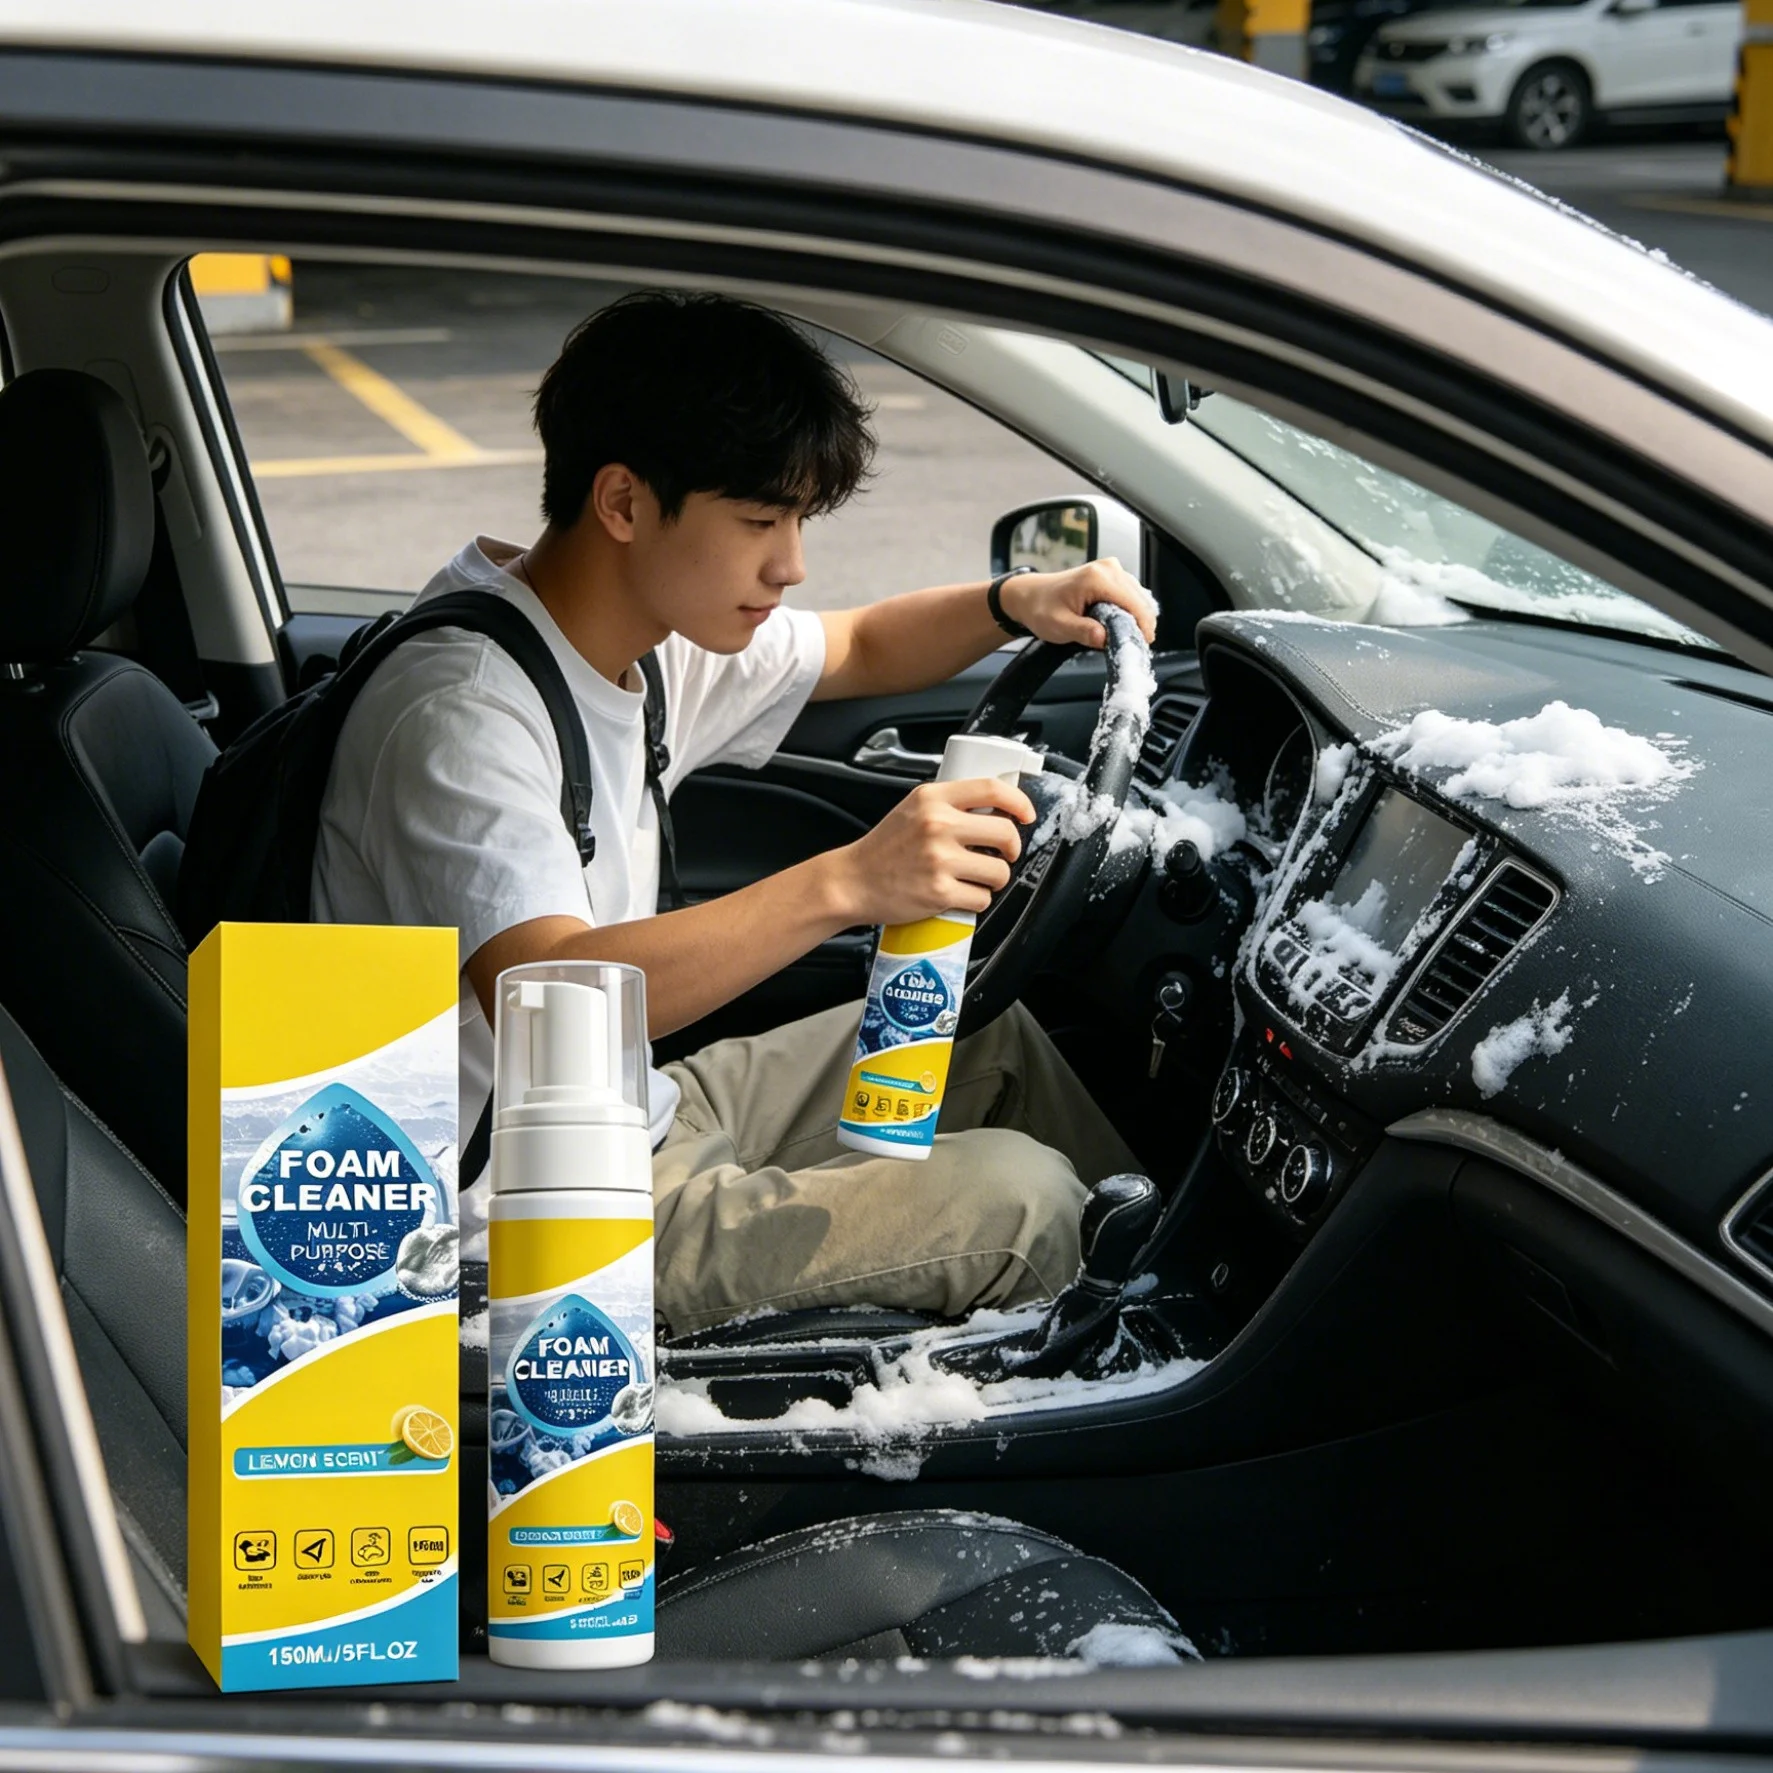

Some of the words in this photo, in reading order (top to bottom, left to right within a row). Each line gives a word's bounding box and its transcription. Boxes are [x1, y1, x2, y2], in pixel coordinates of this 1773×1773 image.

[279, 1149, 401, 1179] FOAM
[240, 1182, 437, 1213] CLEANER
[537, 1335, 610, 1359] FOAM
